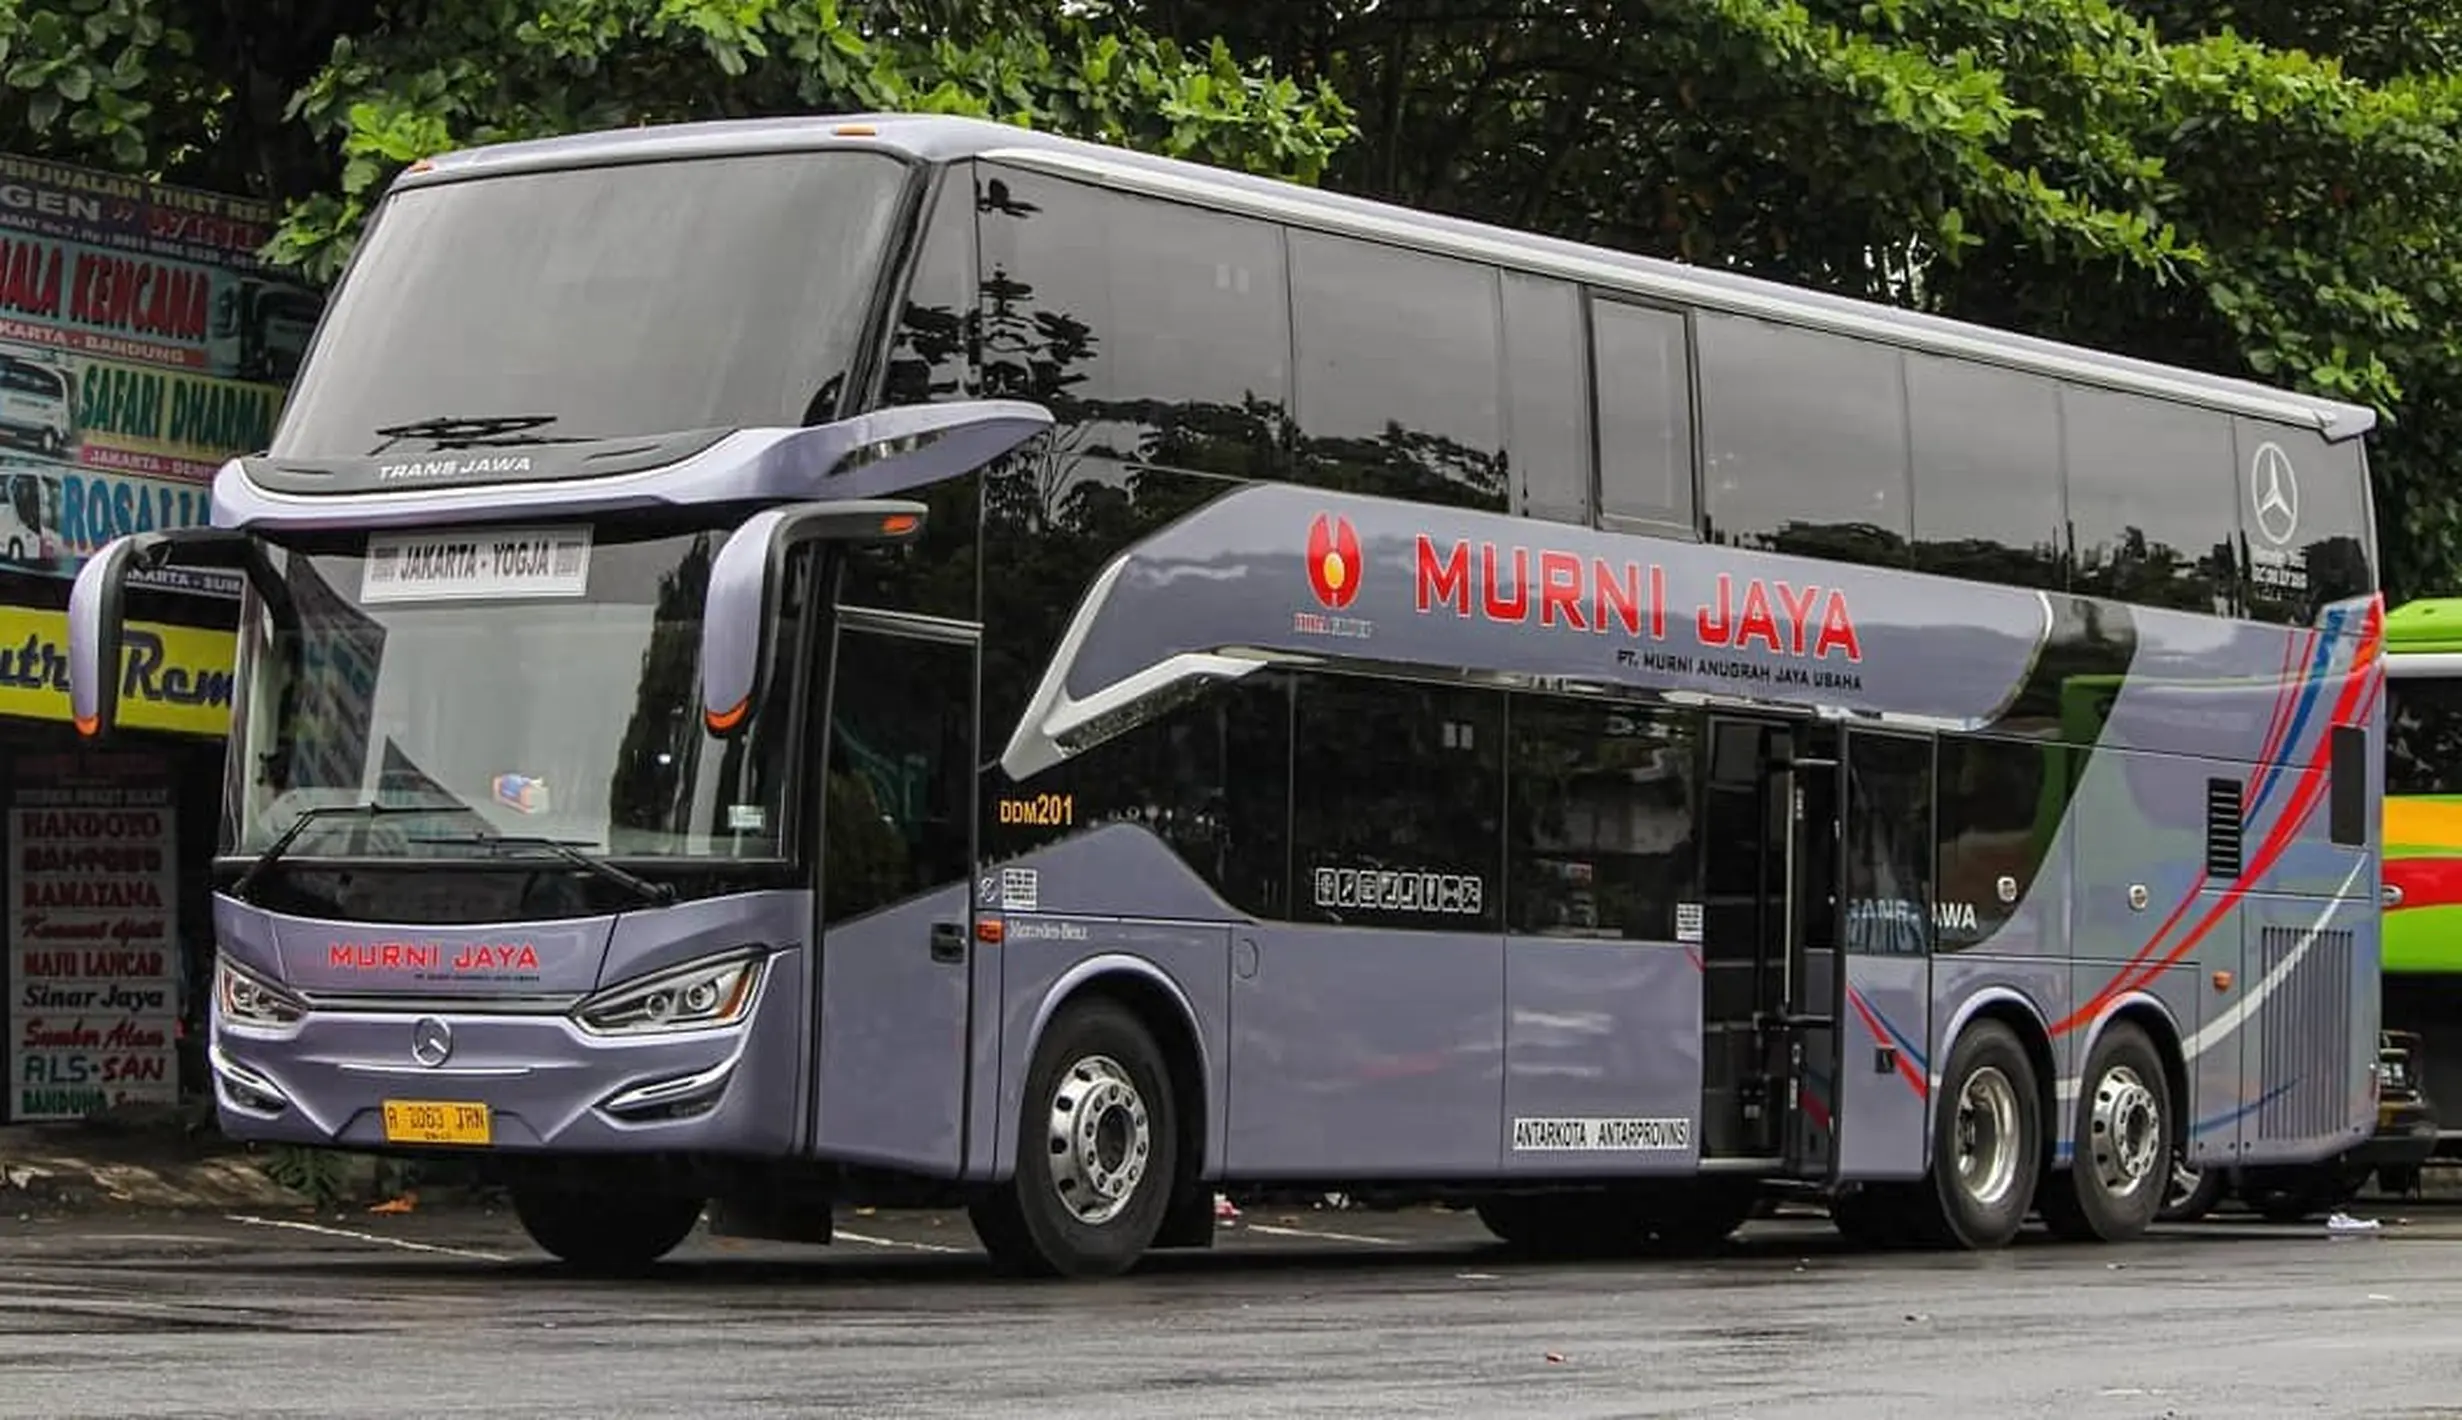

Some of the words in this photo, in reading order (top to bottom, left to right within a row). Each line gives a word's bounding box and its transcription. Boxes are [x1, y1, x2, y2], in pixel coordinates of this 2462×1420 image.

[69, 250, 210, 344] KENCANA
[85, 335, 184, 364] BANDUNG
[80, 363, 165, 439] SAFARI
[379, 462, 457, 480] TRANS
[459, 456, 532, 474] JAWA
[400, 543, 476, 581] JAKARTA
[492, 537, 549, 577] YOGJA
[1414, 532, 1665, 641] MURNI
[1696, 571, 1863, 663] JAYA
[1642, 652, 1693, 675] MURNI
[1775, 666, 1810, 687] JAYA
[999, 793, 1073, 825] DDM201
[330, 942, 440, 969] MURNI
[453, 942, 540, 971] JAYA
[23, 983, 97, 1008] Sinar
[101, 985, 163, 1012] Jaya
[24, 1056, 88, 1083] ALS
[103, 1056, 164, 1082] SAN
[1516, 1121, 1587, 1146] ANTARKOTA
